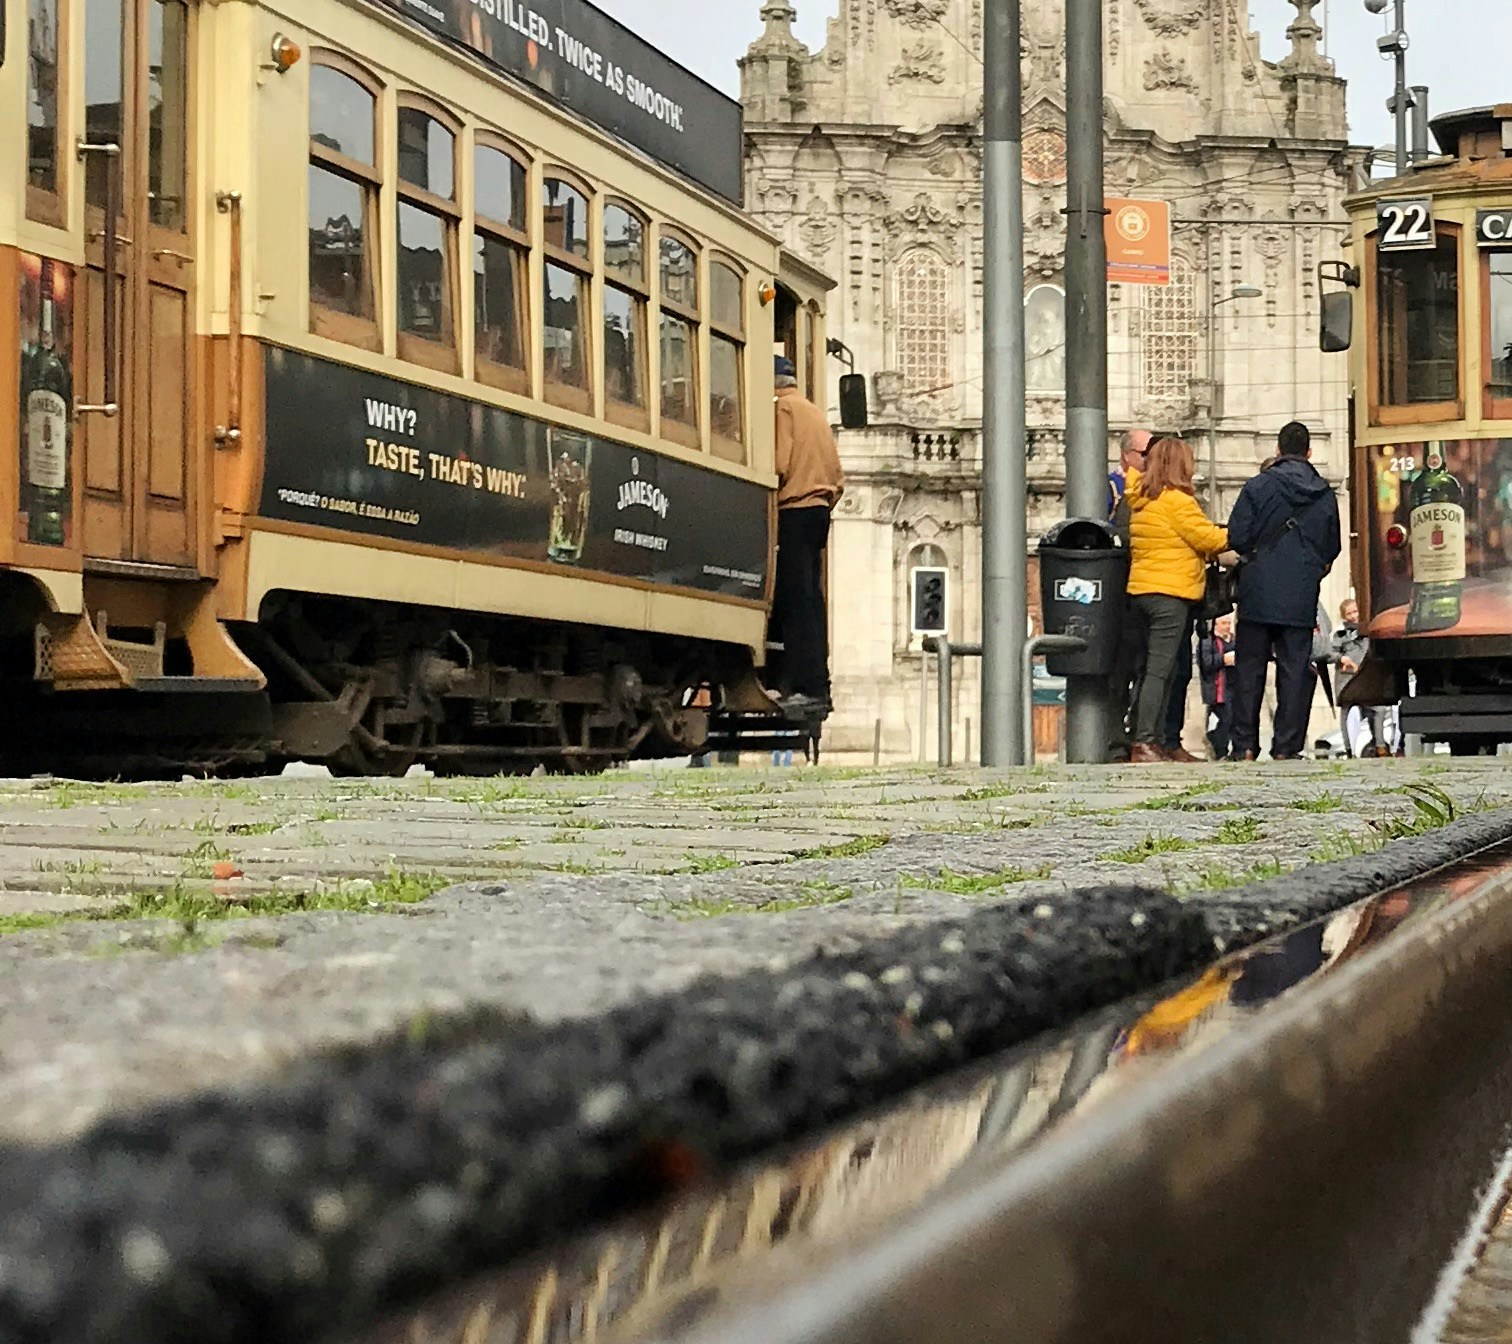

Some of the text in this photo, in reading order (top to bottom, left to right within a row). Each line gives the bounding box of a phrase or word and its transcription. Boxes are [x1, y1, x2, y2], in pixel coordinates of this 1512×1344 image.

[555, 27, 603, 83] TWICE
[605, 61, 624, 96] AS
[1381, 204, 1430, 242] 22
[365, 398, 417, 436] WHY?
[366, 438, 425, 482] TASTE,
[428, 453, 483, 490] THAT'S
[1389, 457, 1415, 472] 213
[617, 480, 669, 519] JAMESON
[1412, 508, 1461, 528] JAMESON
